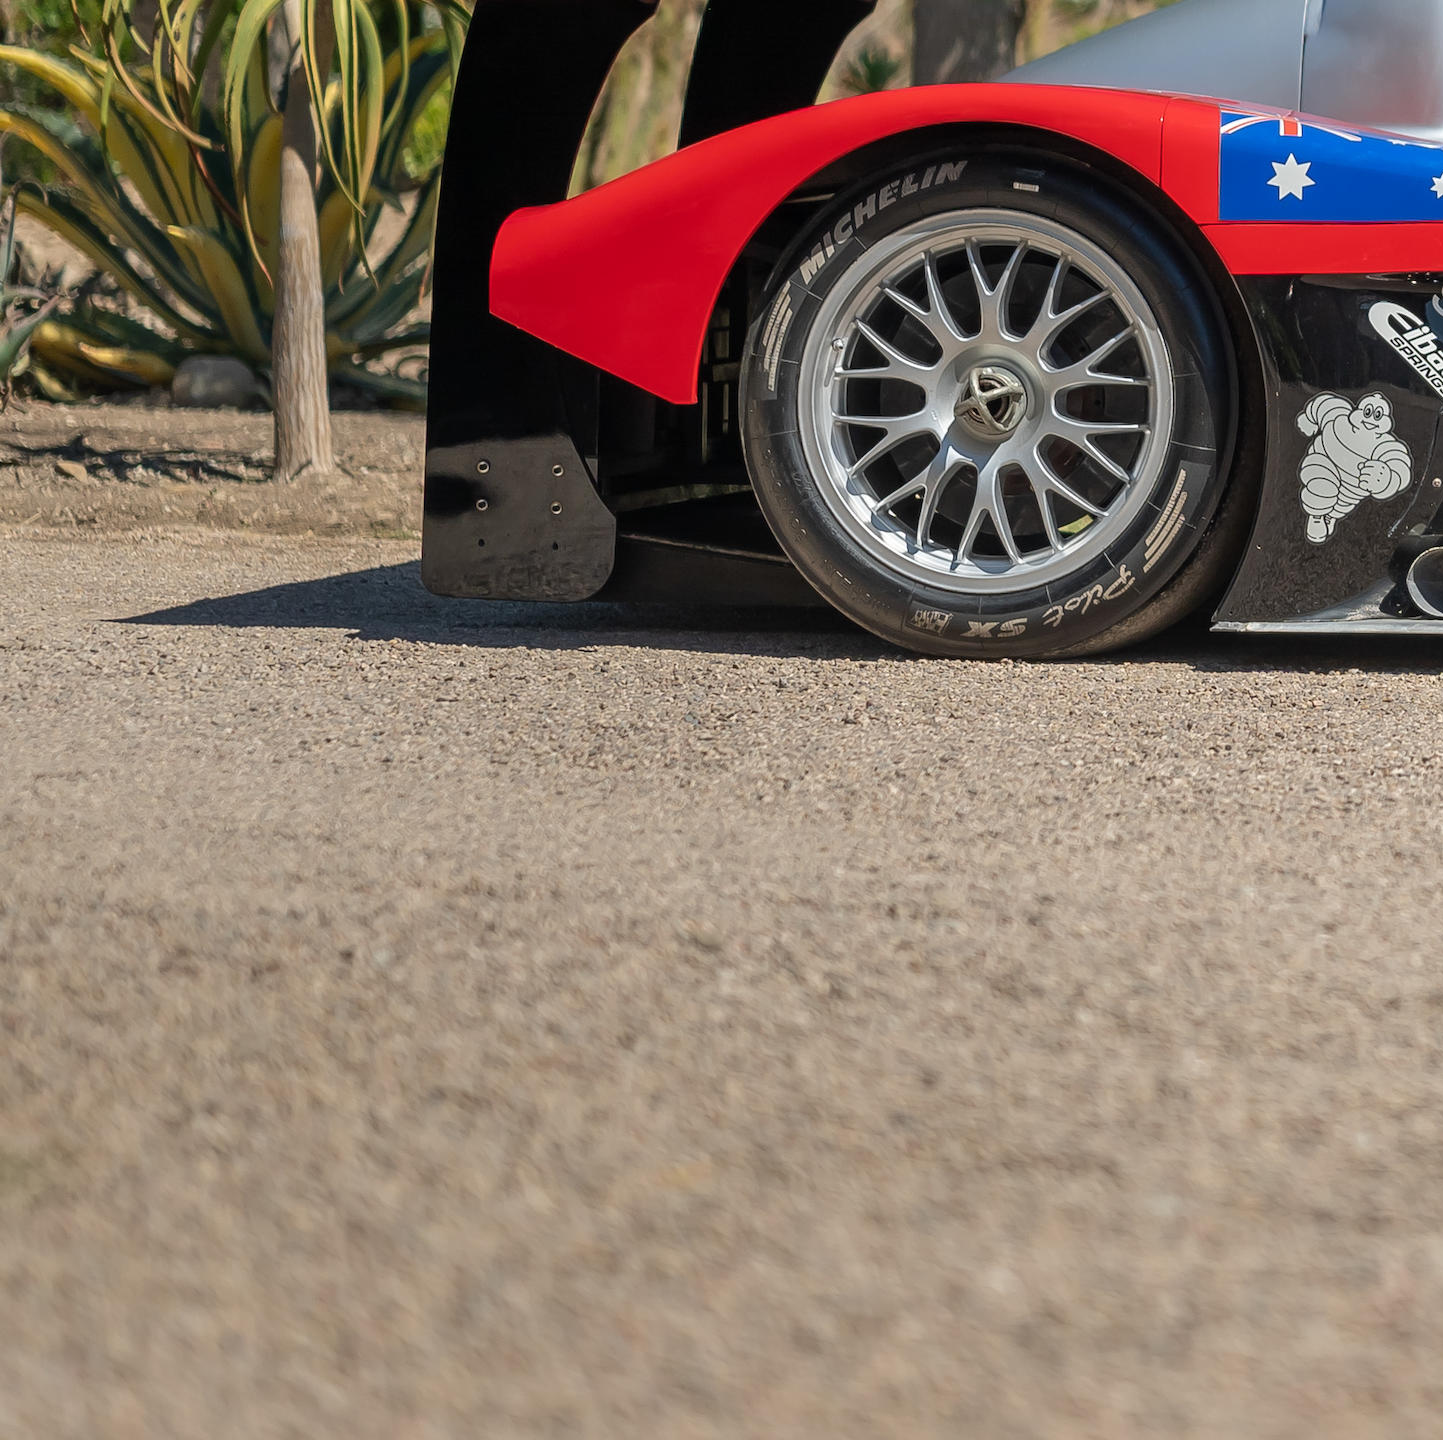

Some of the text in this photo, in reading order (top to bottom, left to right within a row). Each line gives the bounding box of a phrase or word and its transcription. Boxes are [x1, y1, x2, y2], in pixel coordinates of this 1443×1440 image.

[799, 160, 969, 286] MICHELIN
[960, 563, 1136, 638] Pilot SX
